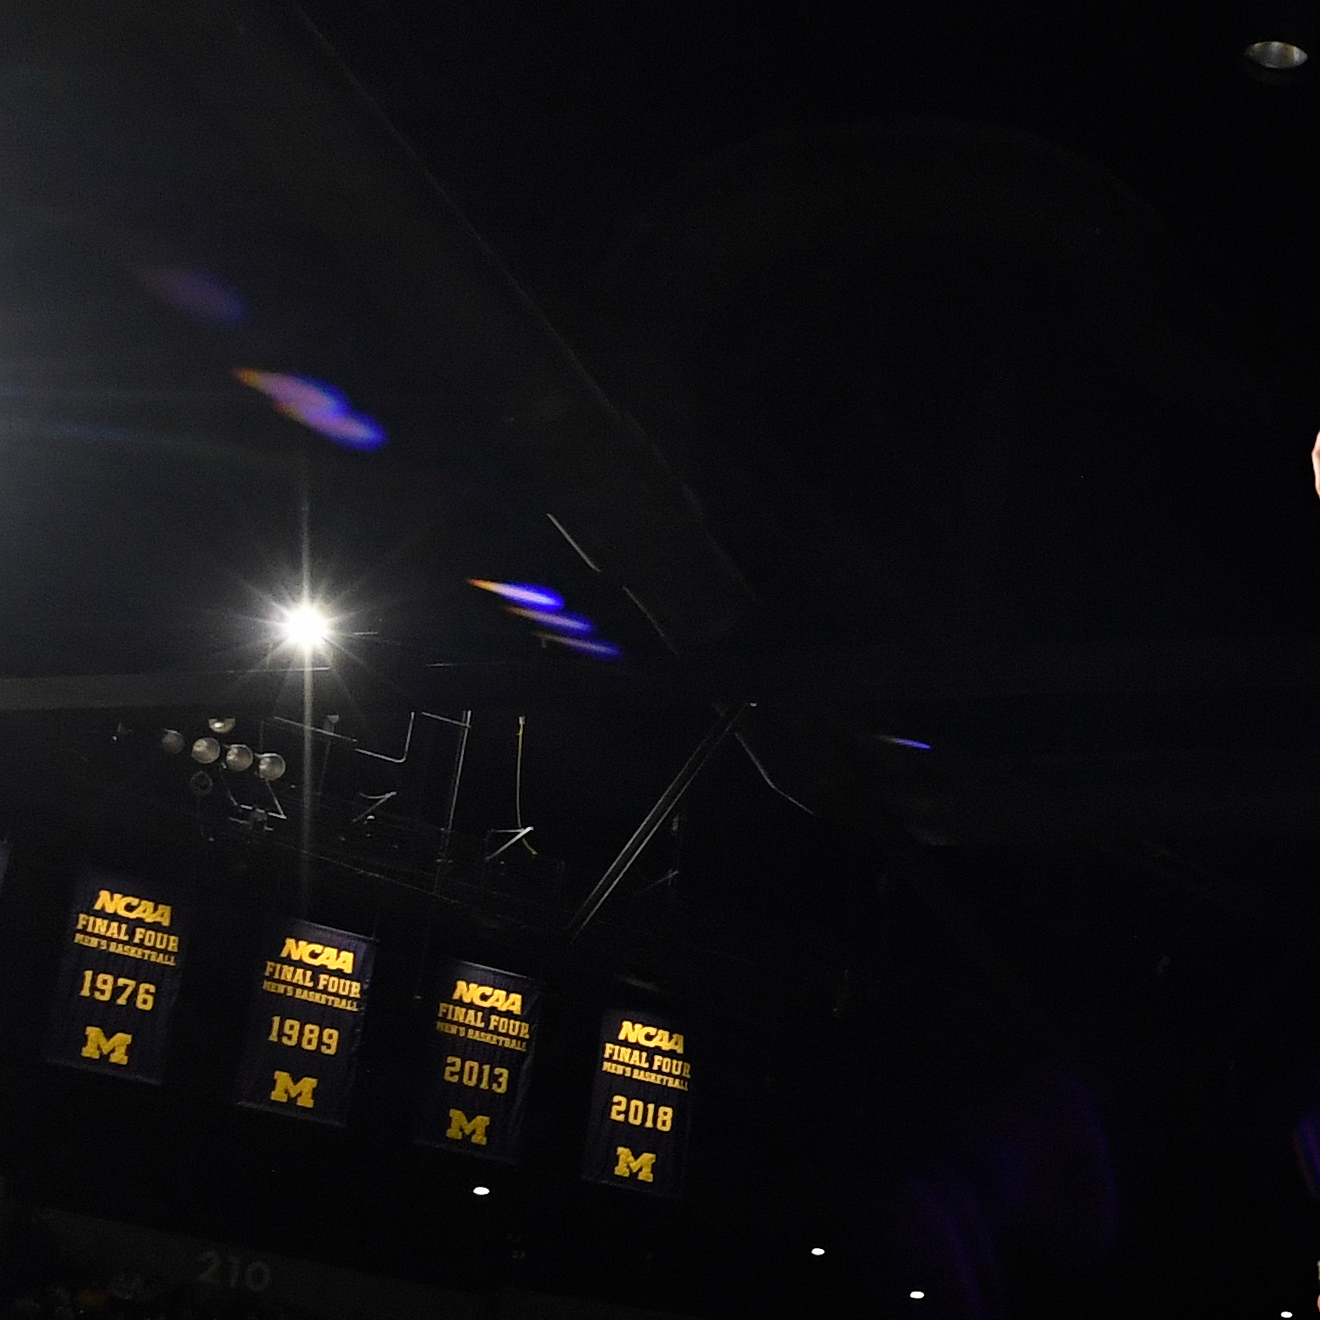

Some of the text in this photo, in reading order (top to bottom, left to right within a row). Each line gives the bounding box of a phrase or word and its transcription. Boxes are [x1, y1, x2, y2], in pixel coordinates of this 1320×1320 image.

[94, 889, 173, 927] NCAA
[74, 932, 177, 967] MEN'S BASKETBALL
[77, 913, 180, 953] FINAL FOUR
[280, 937, 356, 975] NCAA
[80, 969, 157, 1012] 1976
[263, 979, 360, 1013] MEN'S BASKETBALL
[264, 960, 362, 999] FINAL FOUR
[451, 979, 523, 1015] NCAA
[268, 1015, 340, 1057] 1989
[437, 1002, 531, 1040] FINAL FOUR
[617, 1020, 686, 1054] NCAA
[81, 1026, 133, 1066] M
[604, 1042, 692, 1079] FINAL FOUR
[270, 1070, 319, 1109] M
[443, 1055, 510, 1095] 2013
[602, 1060, 690, 1092] MEN'S BASKETBALL
[446, 1108, 491, 1146] M
[610, 1094, 674, 1133] 2018
[614, 1146, 657, 1183] M
